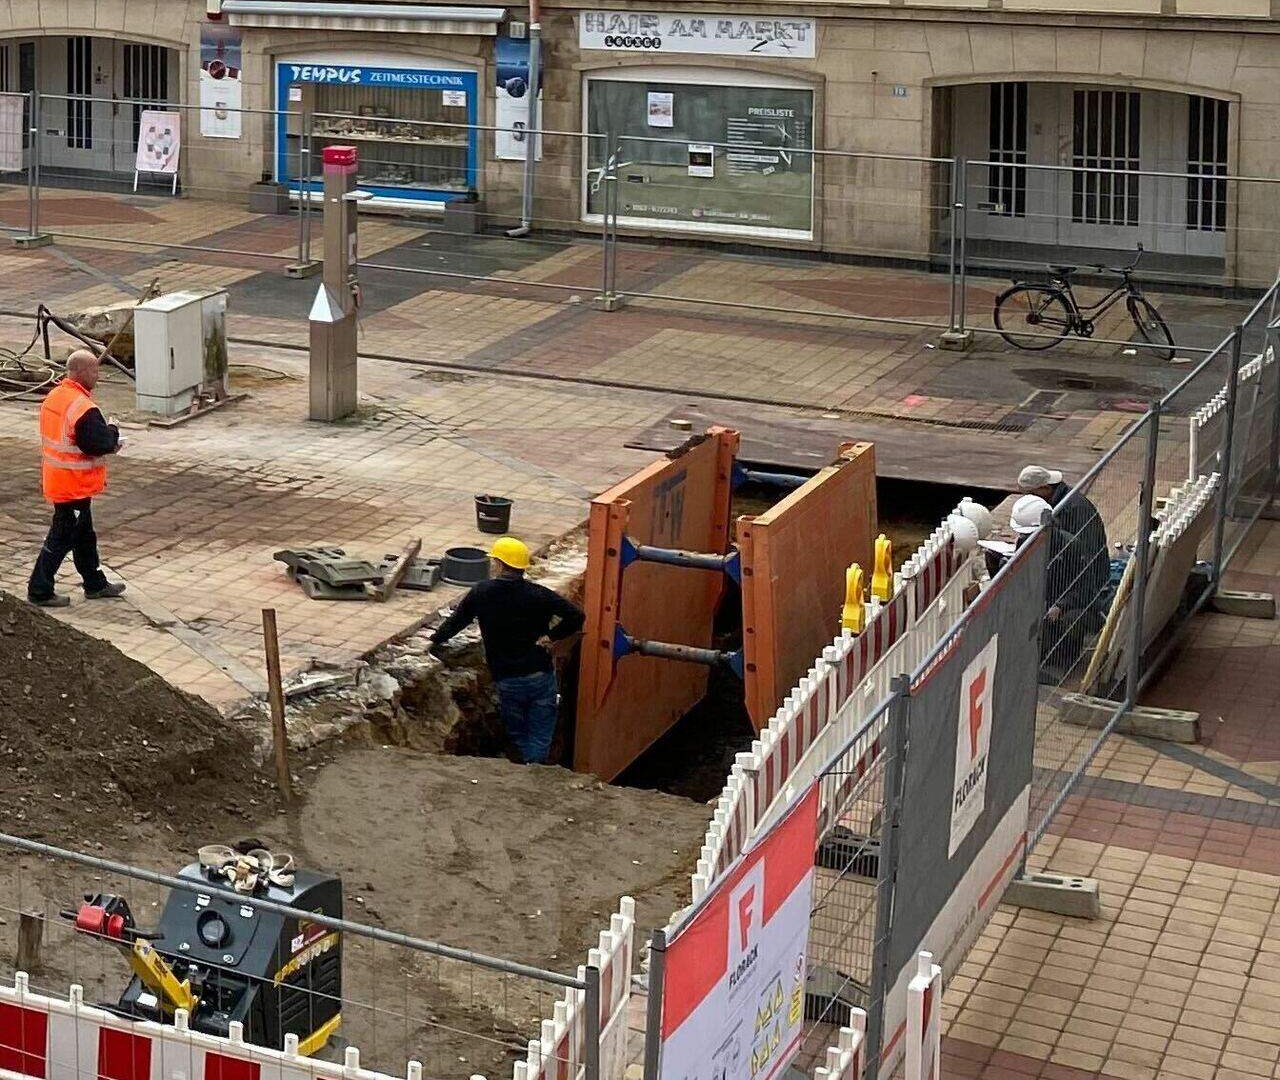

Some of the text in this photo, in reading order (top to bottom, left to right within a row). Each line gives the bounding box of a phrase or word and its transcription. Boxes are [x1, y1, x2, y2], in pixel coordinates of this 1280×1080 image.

[585, 13, 811, 41] HAIR AM MARKT
[290, 66, 464, 85] TEMPUS ZEITMESSTECHNIK
[748, 107, 794, 117] PREISLISTE
[729, 943, 759, 990] FLORACK
